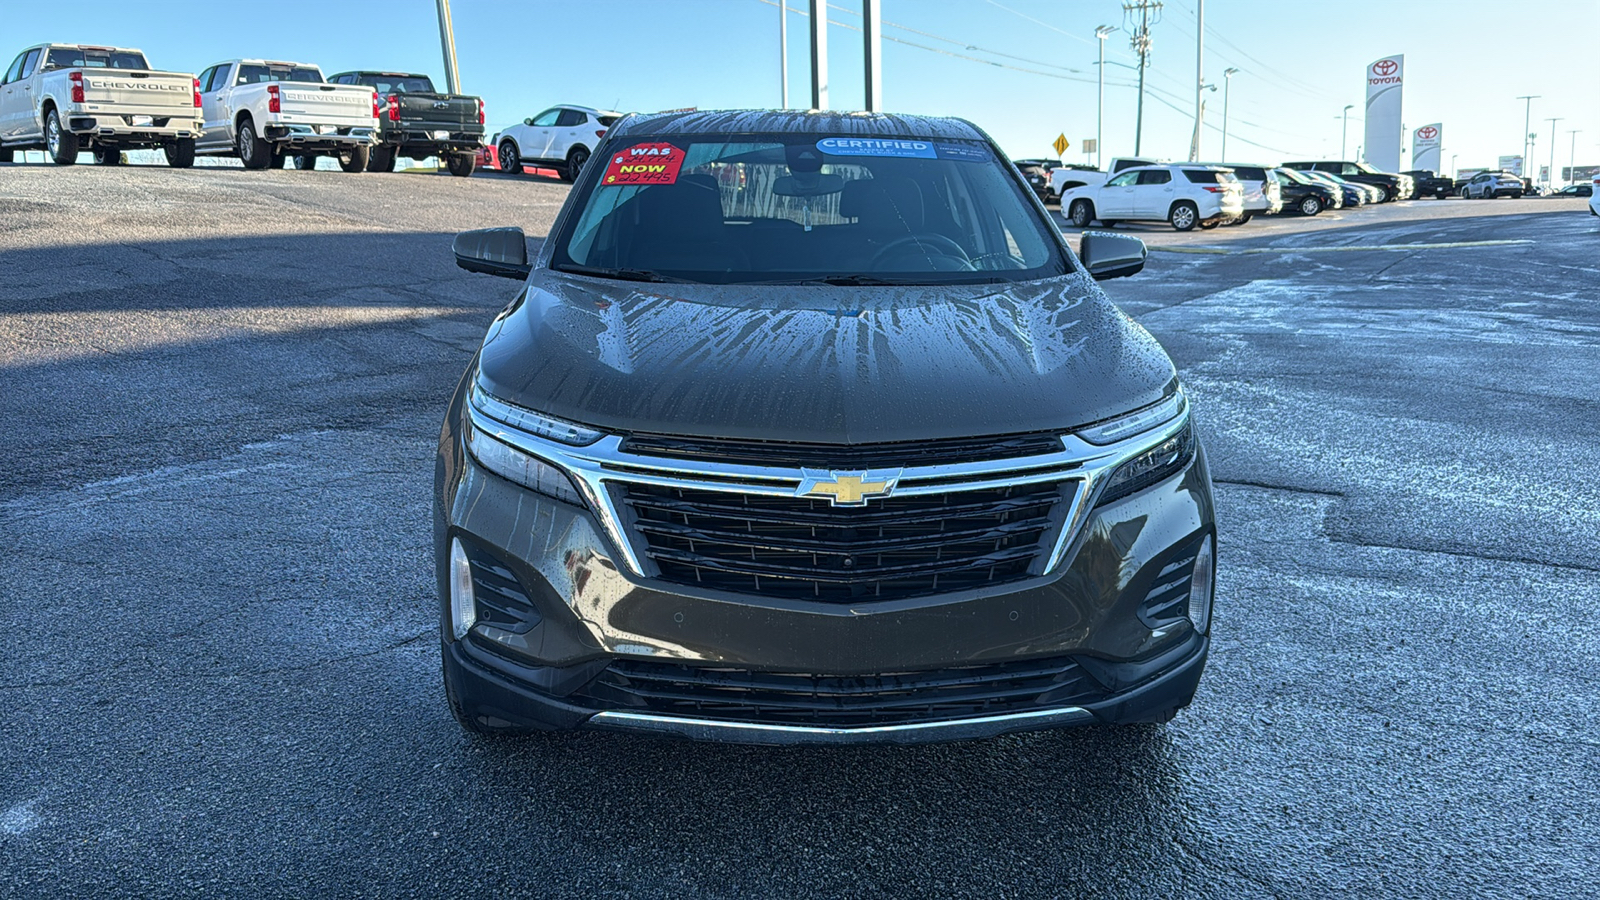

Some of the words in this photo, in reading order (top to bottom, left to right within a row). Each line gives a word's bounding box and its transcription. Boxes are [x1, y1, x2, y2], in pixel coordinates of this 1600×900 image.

[1368, 76, 1402, 85] TOYOTA
[92, 81, 188, 91] CHEVROLET
[287, 93, 367, 104] CHEVROLET
[822, 140, 928, 151] CERTIFIED
[631, 147, 671, 156] WAS
[620, 164, 667, 173] NOW
